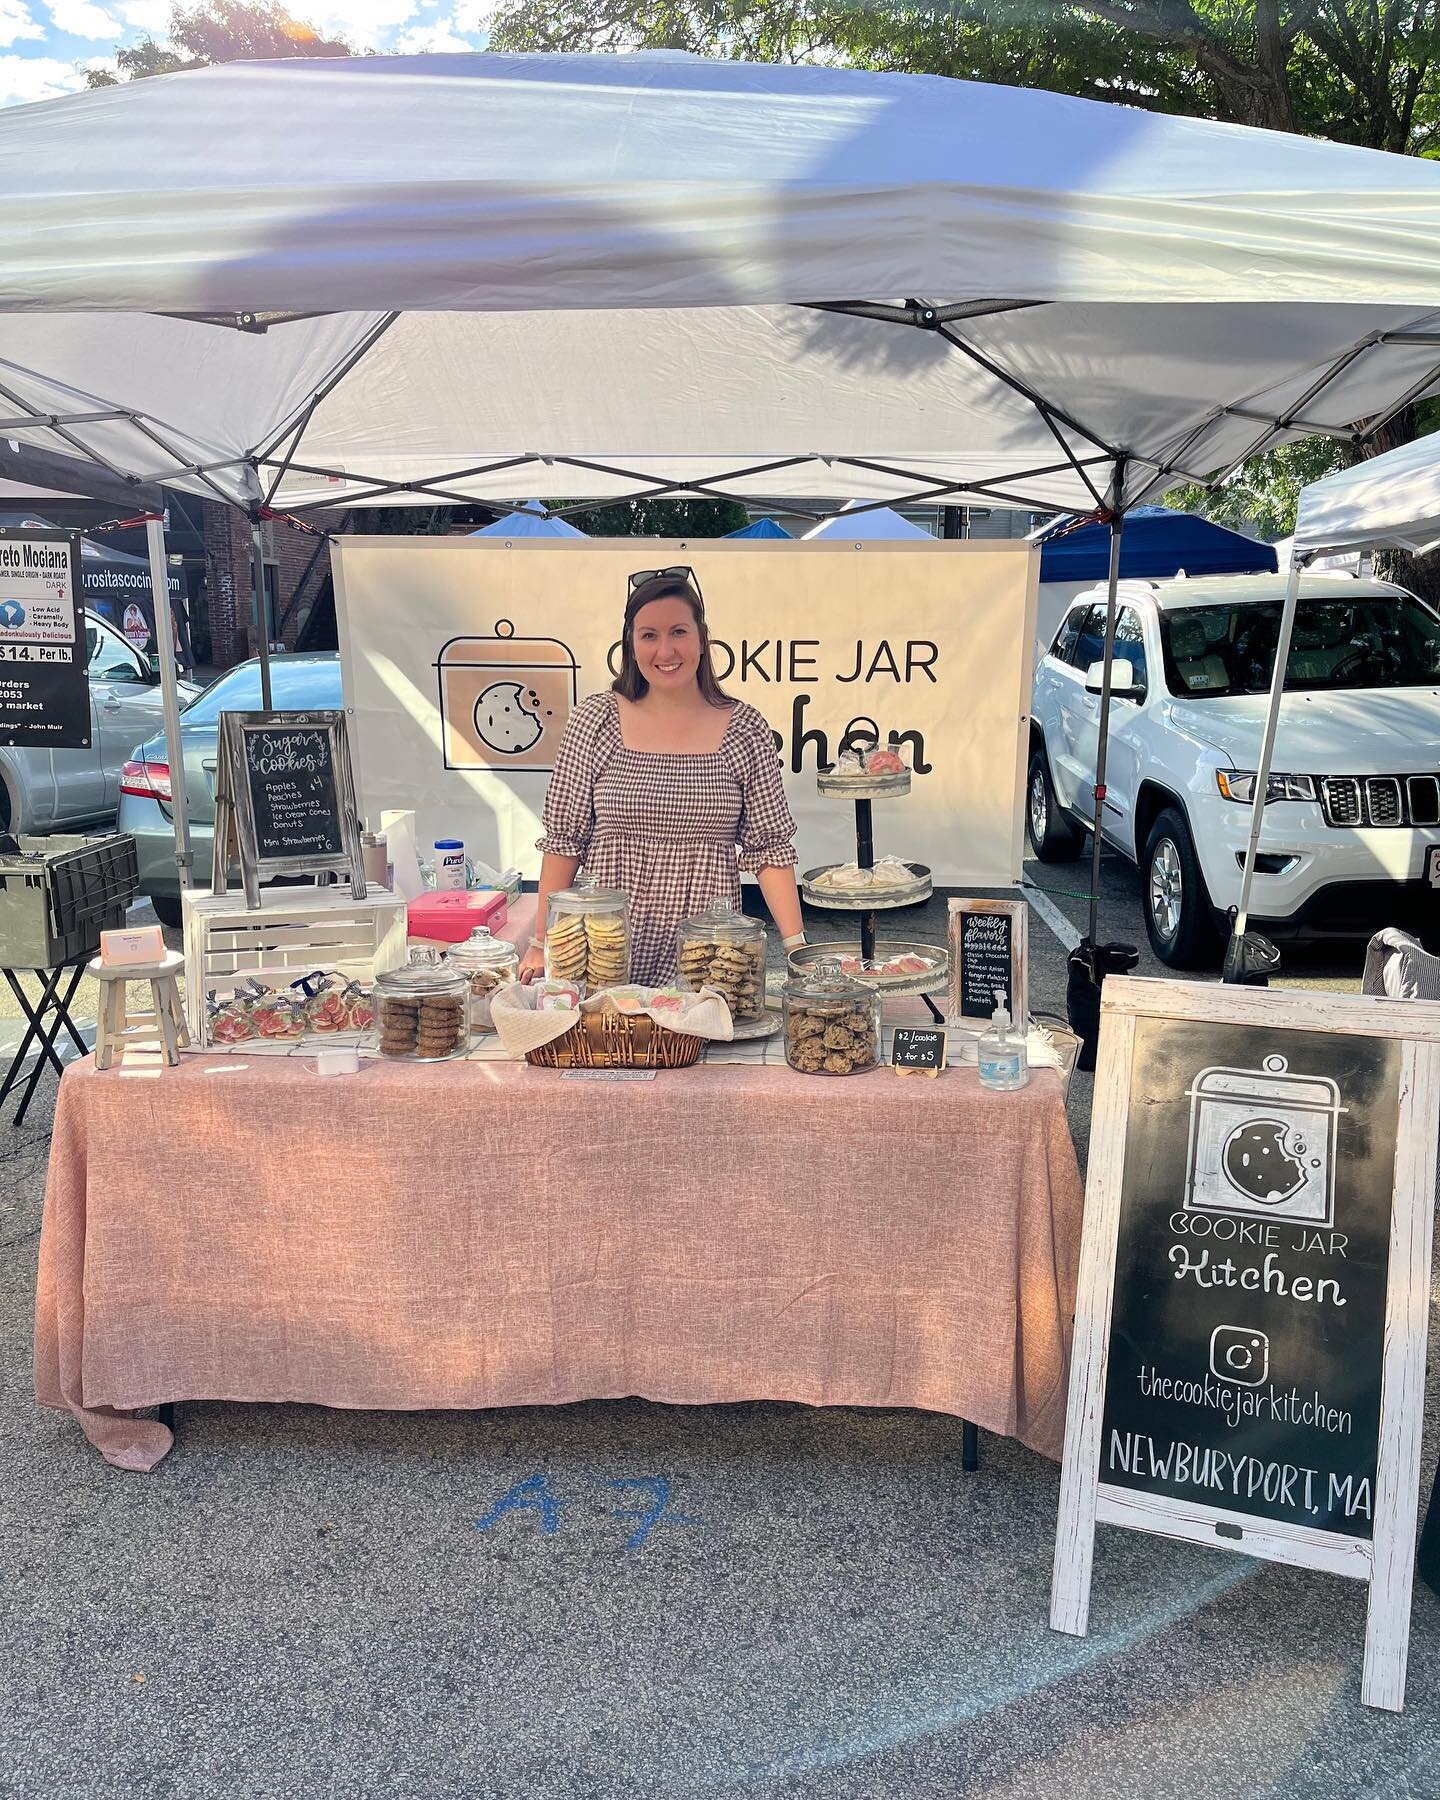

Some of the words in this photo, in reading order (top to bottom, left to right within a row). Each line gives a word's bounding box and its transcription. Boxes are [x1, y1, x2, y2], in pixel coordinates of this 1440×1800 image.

[46, 581, 67, 589] DARK
[53, 621, 69, 629] Body
[43, 631, 72, 639] Delicious
[40, 648, 56, 660] Per
[59, 648, 71, 661] lb.
[835, 640, 938, 683] JAR
[0, 680, 30, 689] rders
[6, 701, 44, 710] market
[262, 732, 313, 756] Sugar
[260, 752, 316, 775] Cookies
[265, 782, 297, 793] Apples
[268, 791, 302, 802] Peaches
[271, 800, 321, 812] Strawberries
[272, 812, 283, 820] Ice
[285, 810, 306, 819] Cream
[309, 808, 331, 816] Cones
[273, 820, 304, 829] Donuts
[263, 838, 280, 847] Mini
[282, 833, 326, 846] Strawberries
[966, 916, 1008, 935] Weekly
[964, 927, 1008, 945] flavors
[968, 971, 986, 981] Ginger
[895, 1052, 902, 1061] 3
[905, 1052, 918, 1061] for
[921, 1050, 934, 1061] $5
[1169, 1211, 1281, 1248] COOKIE
[1291, 1230, 1349, 1258] JAR
[1168, 1244, 1347, 1306] Kitchen
[1137, 1365, 1351, 1435] thecookiejarkitchen
[1328, 1472, 1372, 1520] MA
